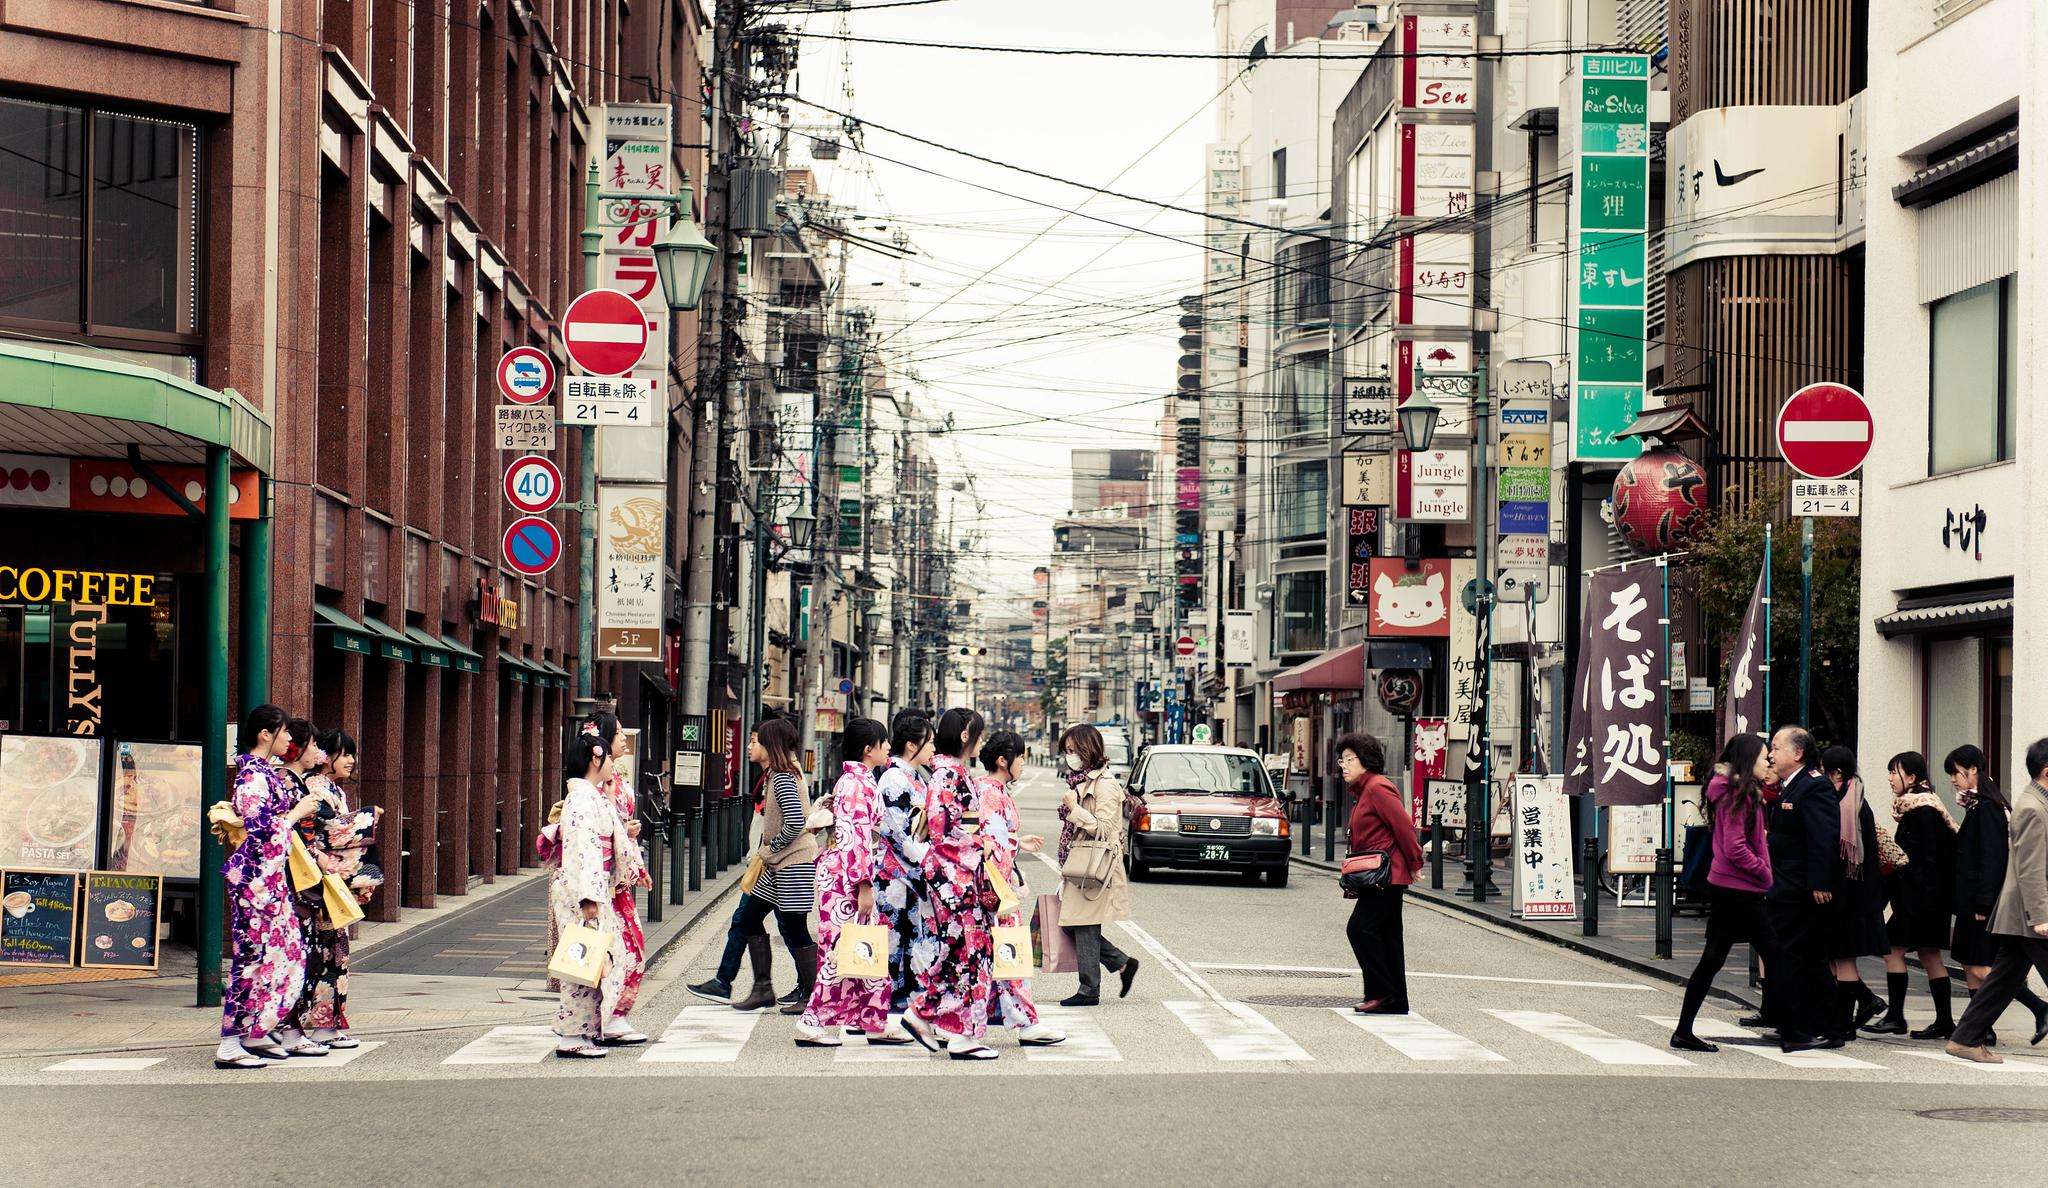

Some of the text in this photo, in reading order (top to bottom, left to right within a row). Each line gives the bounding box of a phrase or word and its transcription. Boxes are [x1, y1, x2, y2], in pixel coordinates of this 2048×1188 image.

[1407, 21, 1414, 31] 3
[1587, 59, 1642, 75] 吉川ビル
[1422, 82, 1468, 105] Sen
[1405, 129, 1412, 139] 2
[1581, 262, 1644, 290] 東すし
[568, 382, 647, 400] 自転車を除く
[1502, 415, 1548, 424] RAUM
[498, 422, 553, 434] マイクロを除く
[1356, 455, 1373, 502] 加美屋
[1417, 465, 1464, 480] Jungle
[518, 472, 549, 497] 40
[1795, 484, 1855, 497] 自転車を除く
[1416, 501, 1464, 516] Jungle
[0, 566, 155, 606] COFFEE
[1601, 582, 1663, 786] そば処
[1435, 799, 1461, 816] 竹寿
[1521, 806, 1544, 869] 営業中
[21, 847, 71, 860] PASTA SET
